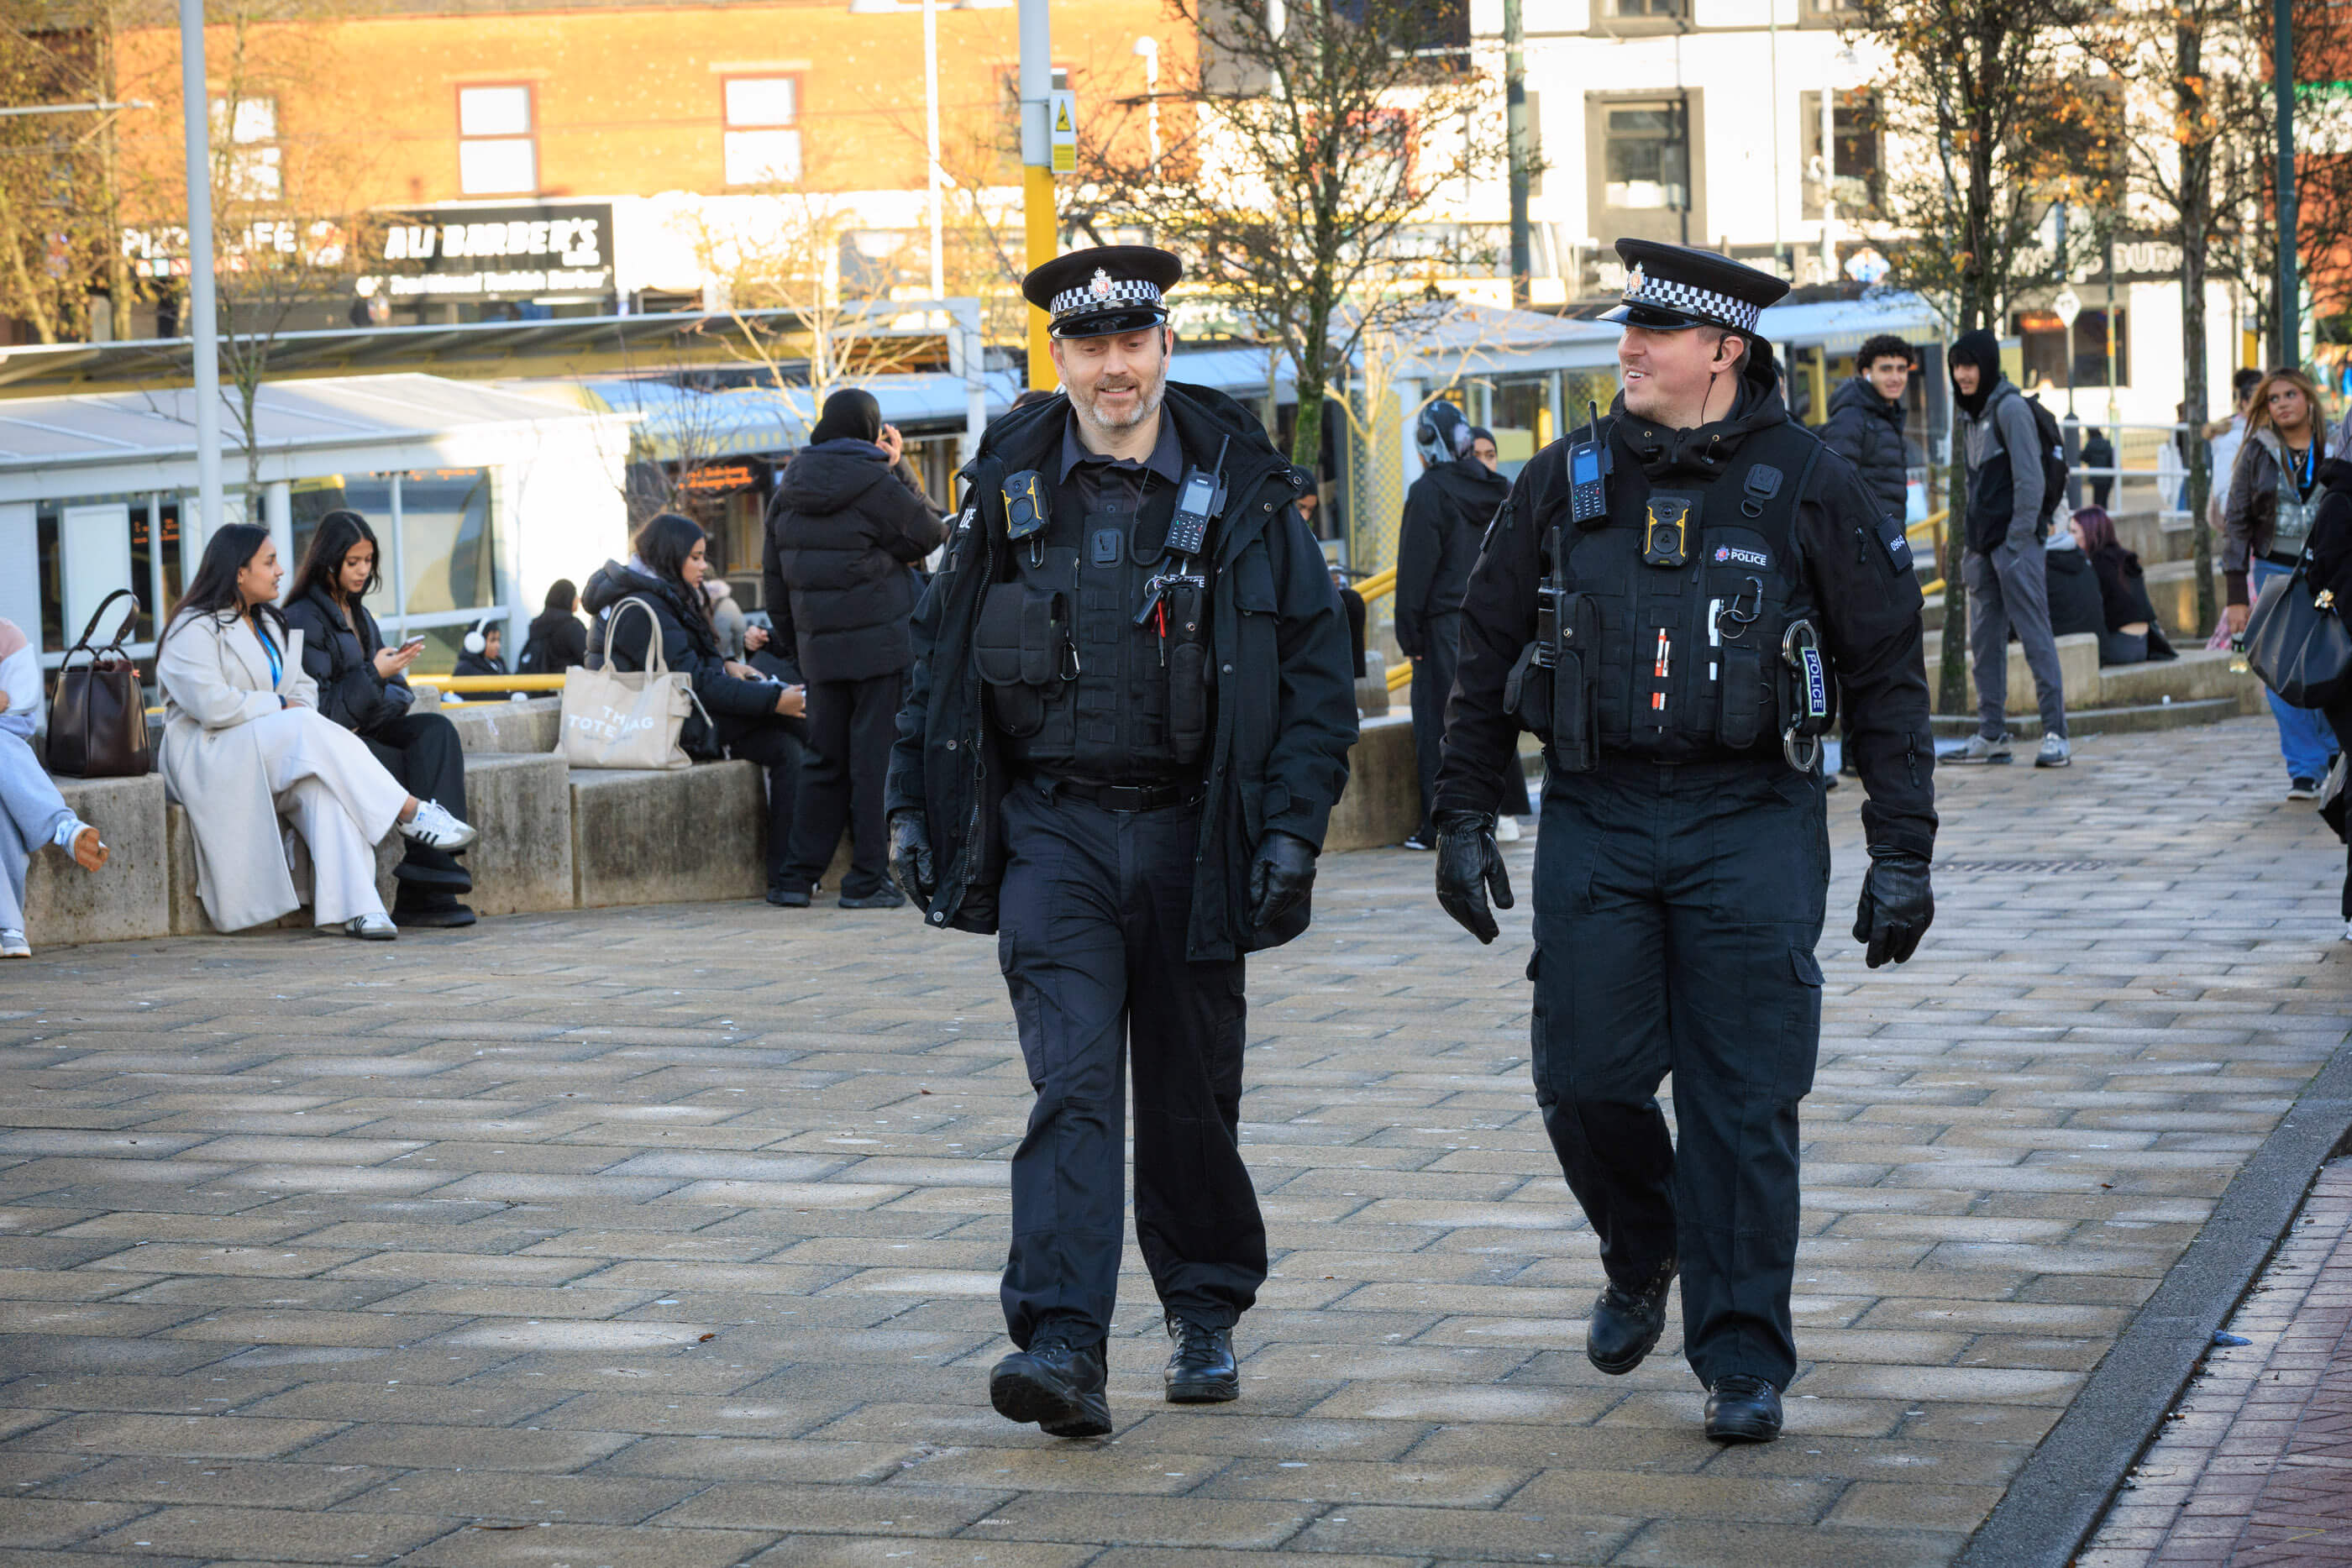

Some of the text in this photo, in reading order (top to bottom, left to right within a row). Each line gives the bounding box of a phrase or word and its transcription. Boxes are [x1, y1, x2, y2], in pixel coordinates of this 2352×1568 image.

[1730, 551, 1767, 566] POLICE
[1807, 653, 1823, 709] POLICE
[568, 713, 617, 738] TOTE
